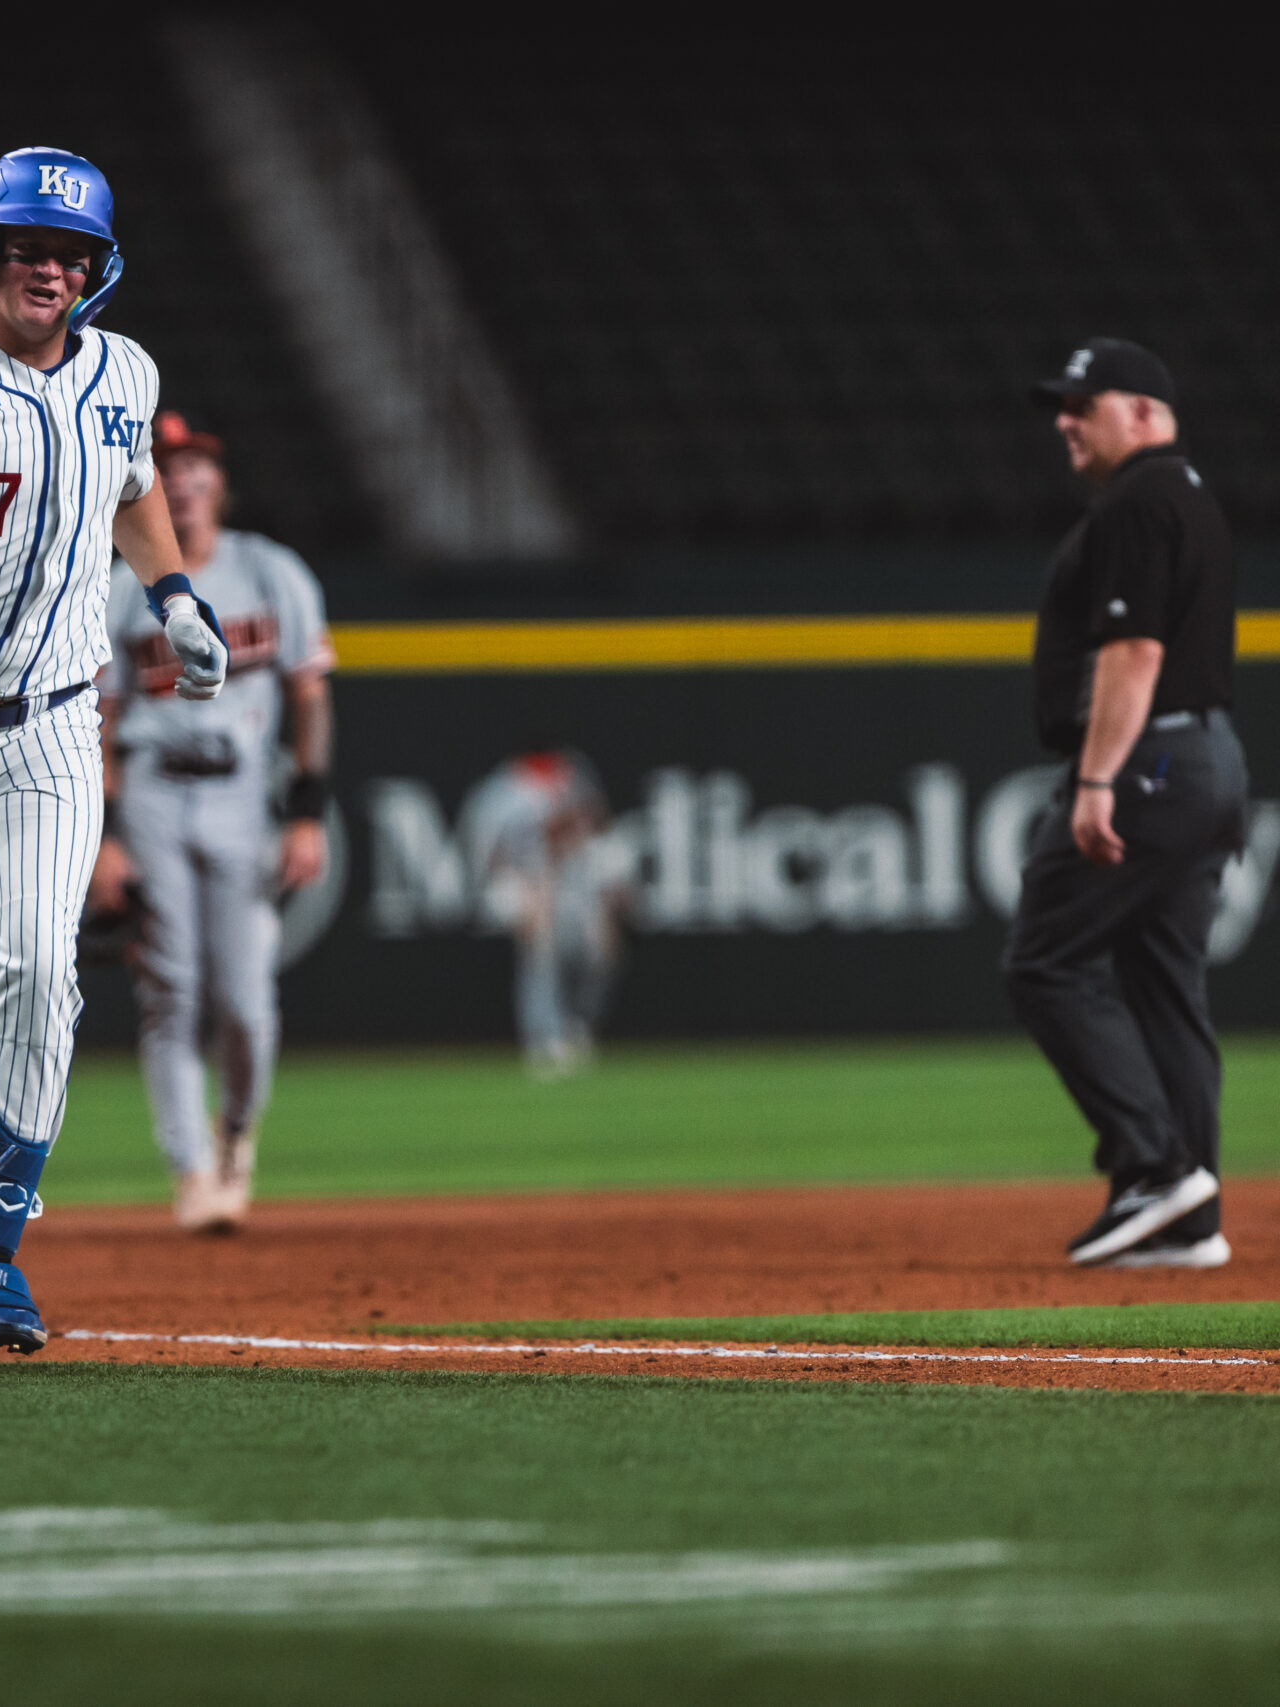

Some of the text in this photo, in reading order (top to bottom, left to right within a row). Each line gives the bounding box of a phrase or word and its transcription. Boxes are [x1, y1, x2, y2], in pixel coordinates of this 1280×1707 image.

[38, 164, 90, 211] KU
[96, 405, 144, 463] KU
[368, 764, 966, 931] Mdical
